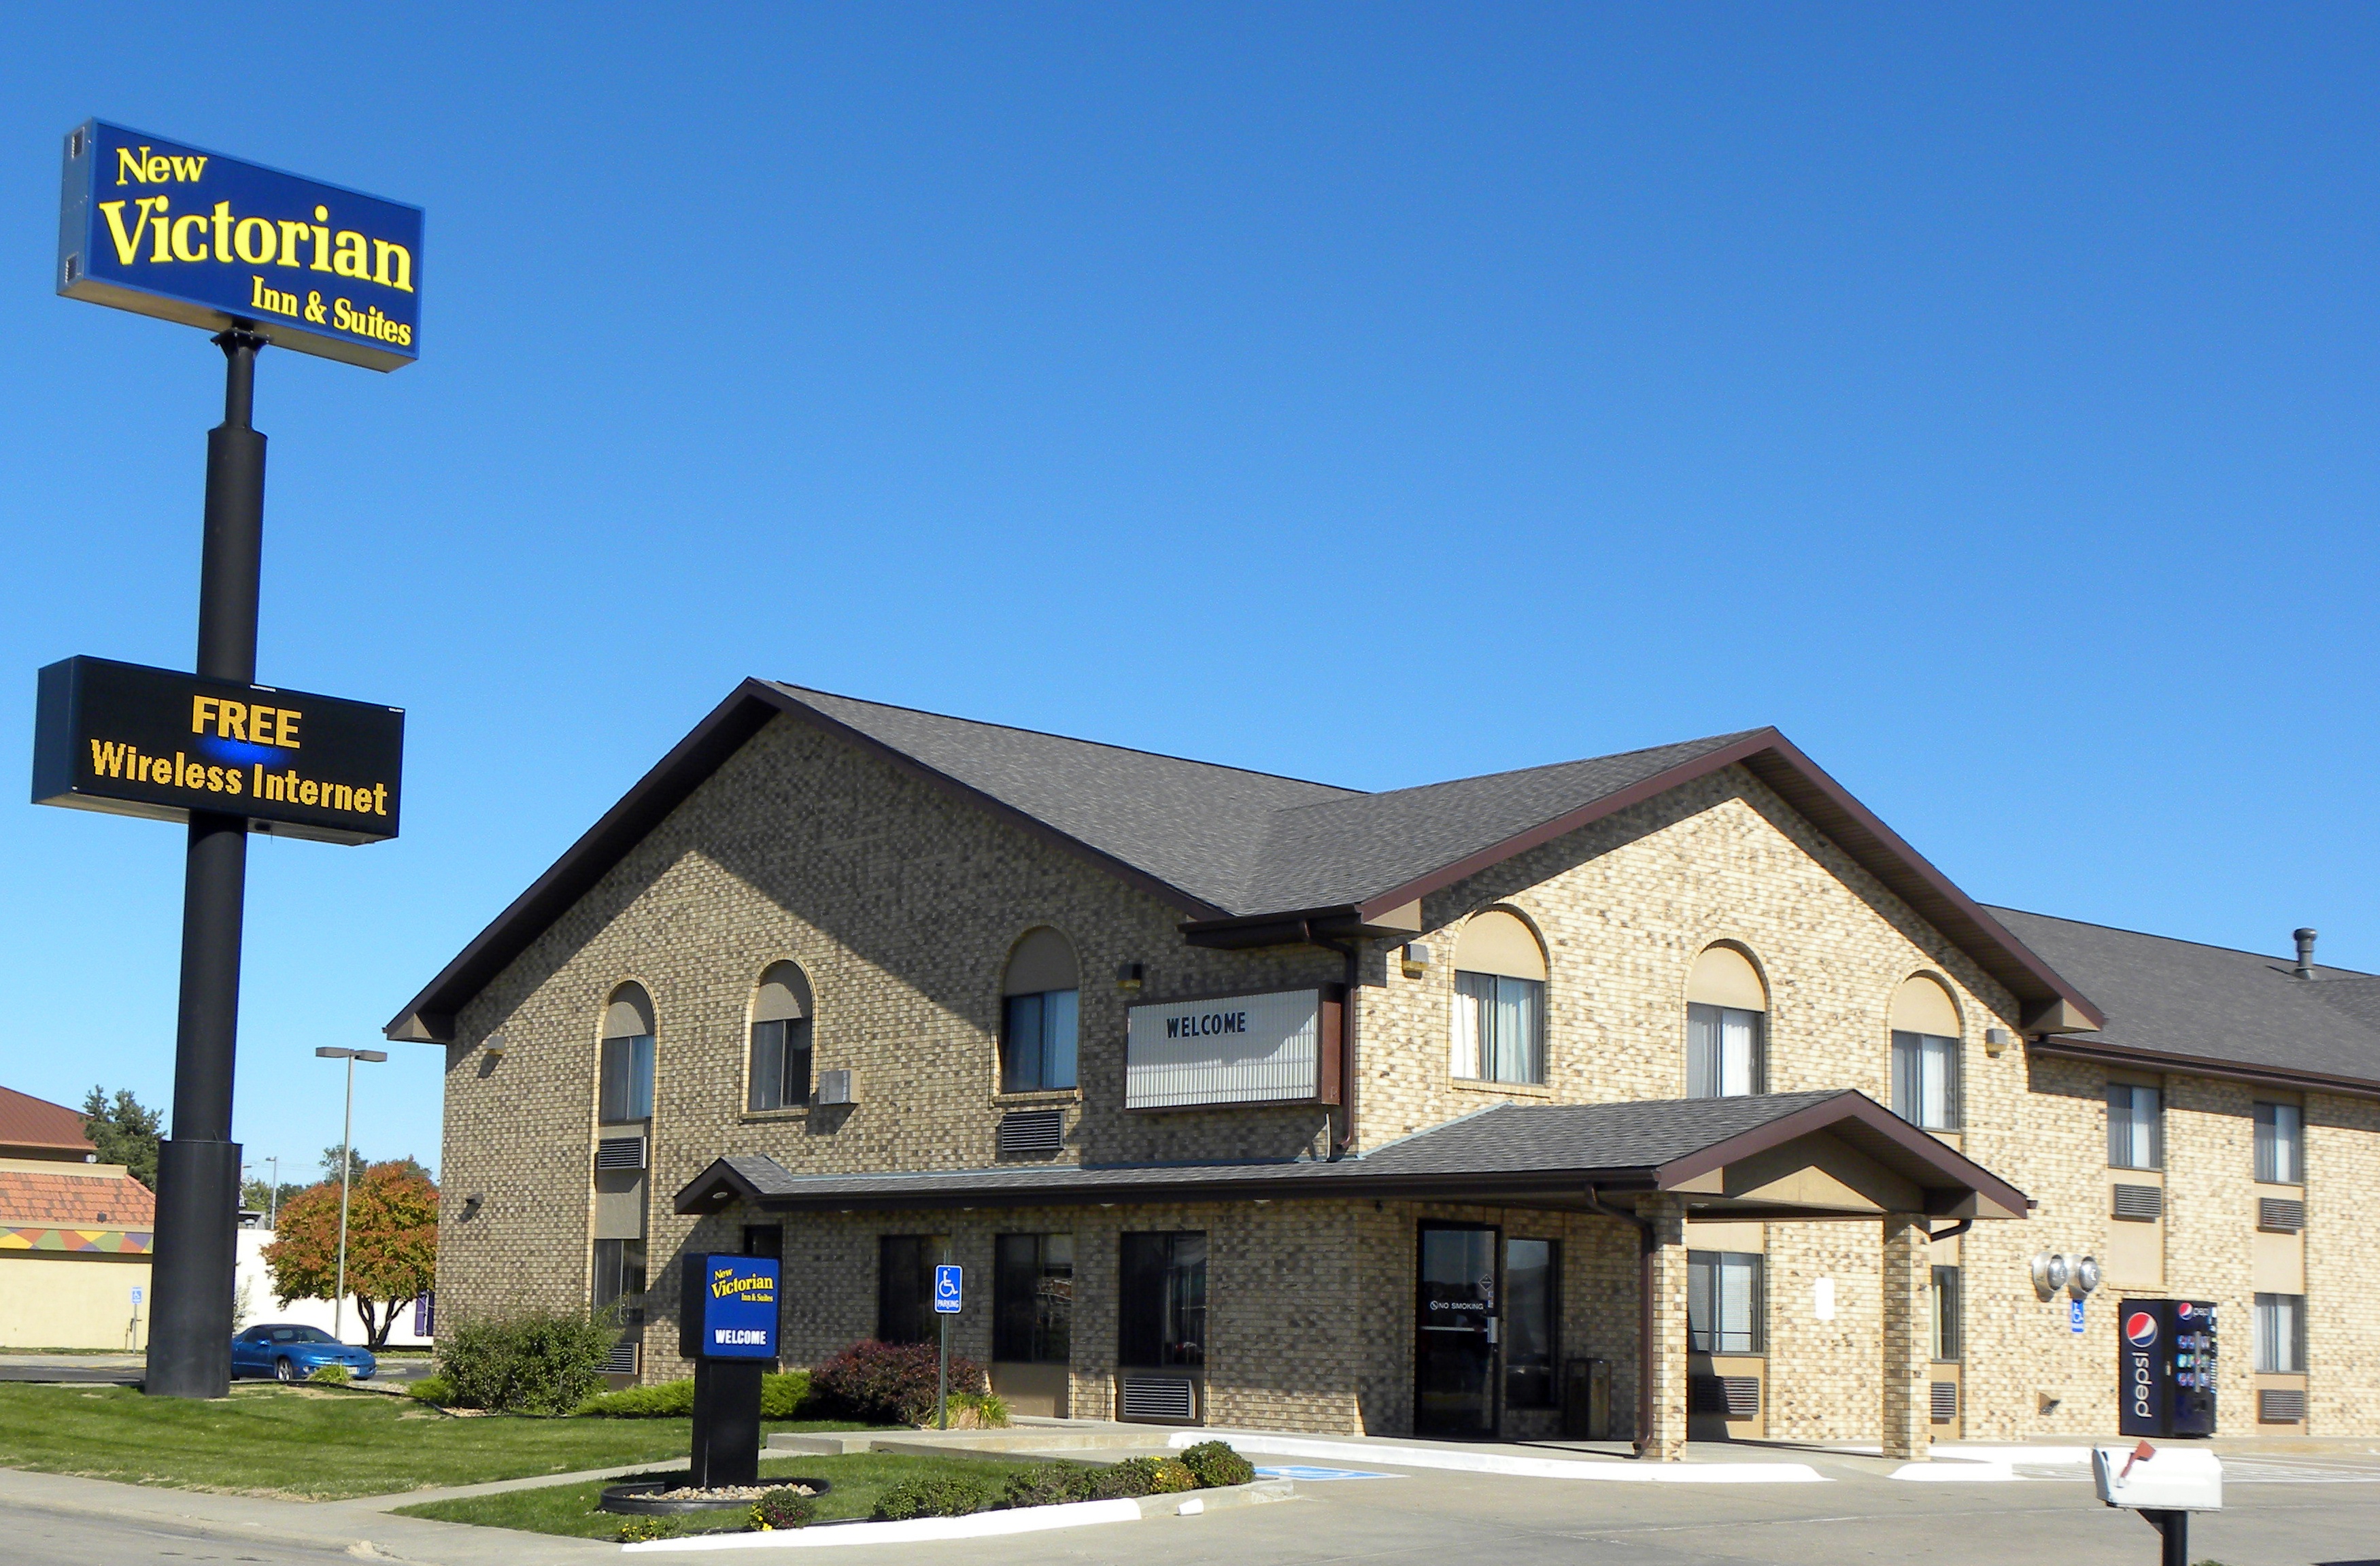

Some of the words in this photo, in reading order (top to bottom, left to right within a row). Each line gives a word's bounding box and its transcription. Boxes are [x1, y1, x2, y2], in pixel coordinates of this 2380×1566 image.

[116, 146, 208, 186] New
[99, 194, 413, 293] Victorian
[251, 275, 299, 318] Inn
[304, 290, 327, 325] &
[333, 297, 412, 346] Suites
[192, 695, 302, 749] FREE
[90, 738, 243, 795] Wireless
[253, 764, 388, 816] Internet
[1166, 1012, 1246, 1038] WELCOME
[711, 1273, 774, 1298] Victorian
[715, 1268, 733, 1280] New
[938, 1299, 959, 1308] PARKING
[715, 1329, 766, 1345] WELCOME
[2131, 1351, 2153, 1418] pepsi
